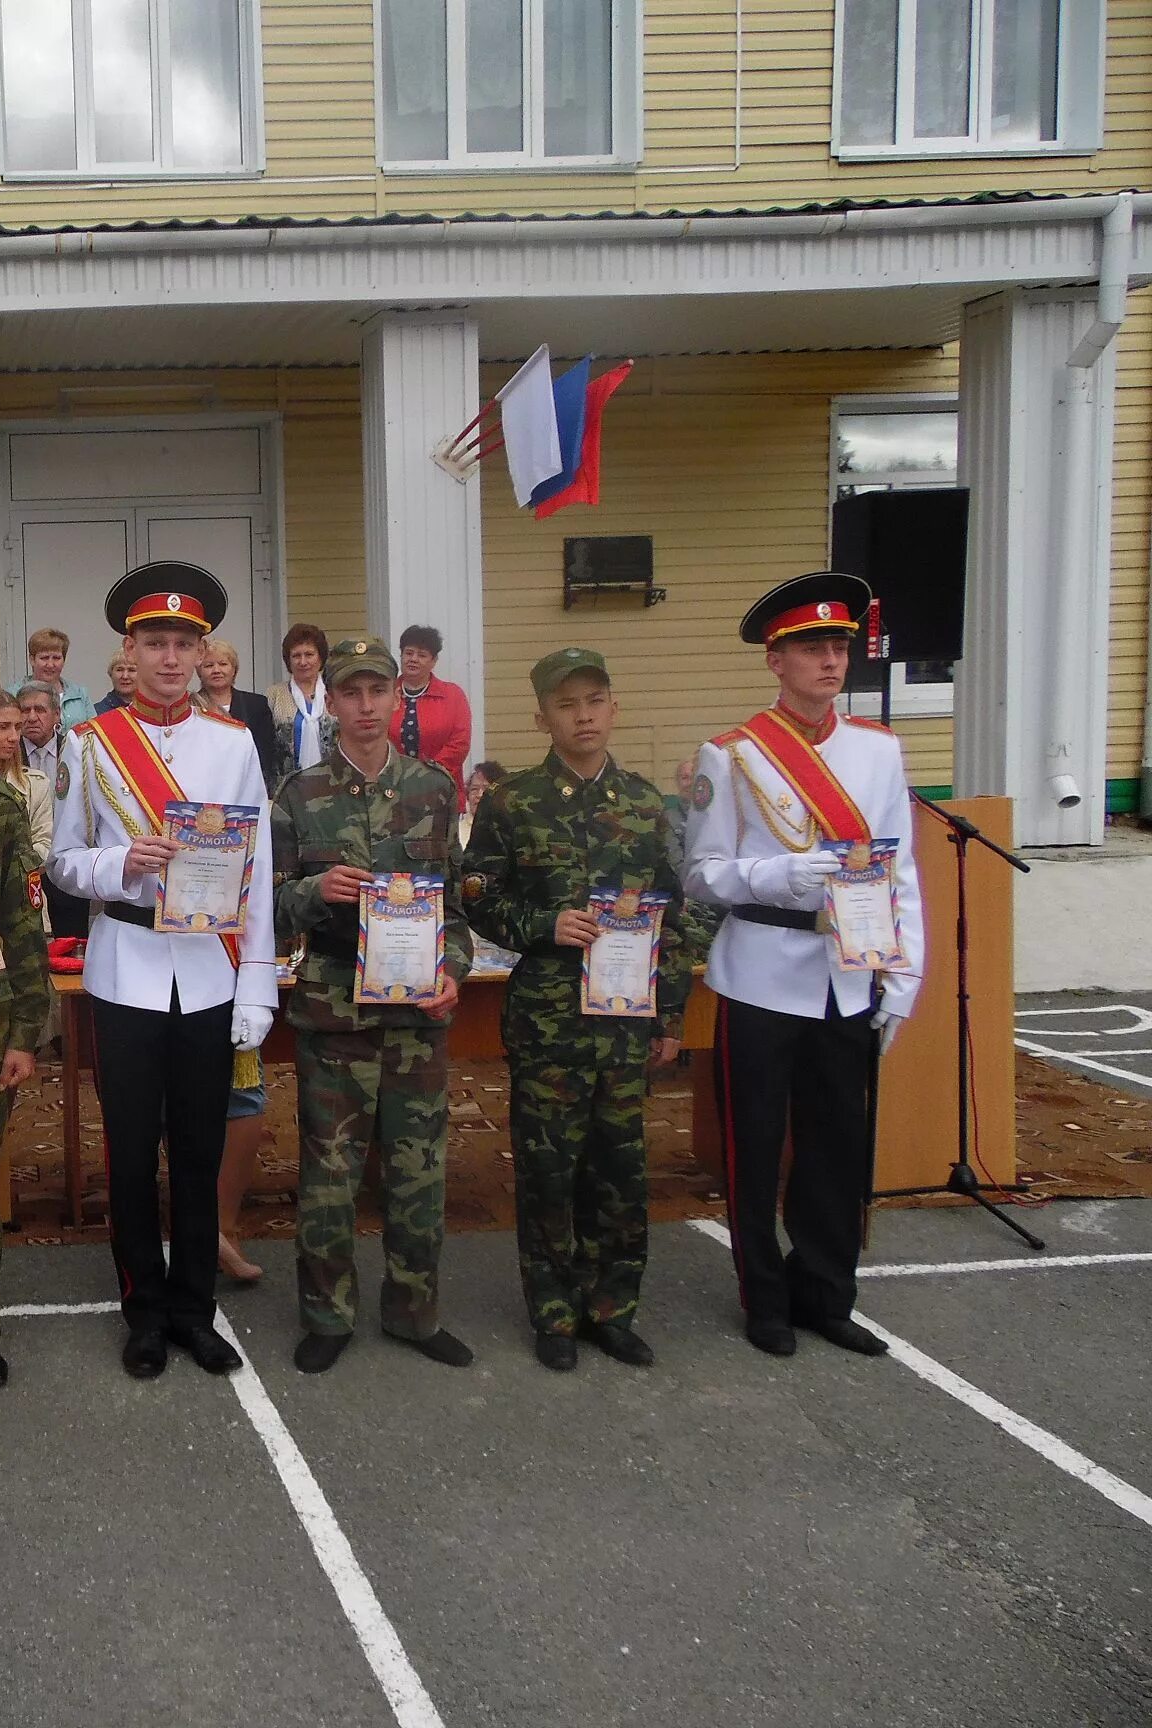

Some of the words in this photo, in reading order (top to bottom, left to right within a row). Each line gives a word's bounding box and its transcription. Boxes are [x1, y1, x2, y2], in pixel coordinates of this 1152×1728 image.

[882, 634, 890, 658] OPERA
[188, 834, 233, 846] ГРАМОТА
[841, 870, 878, 881] ГРАМОТА
[382, 904, 424, 916] ГРАМОТА
[605, 917, 643, 929] ГРАМОТА
